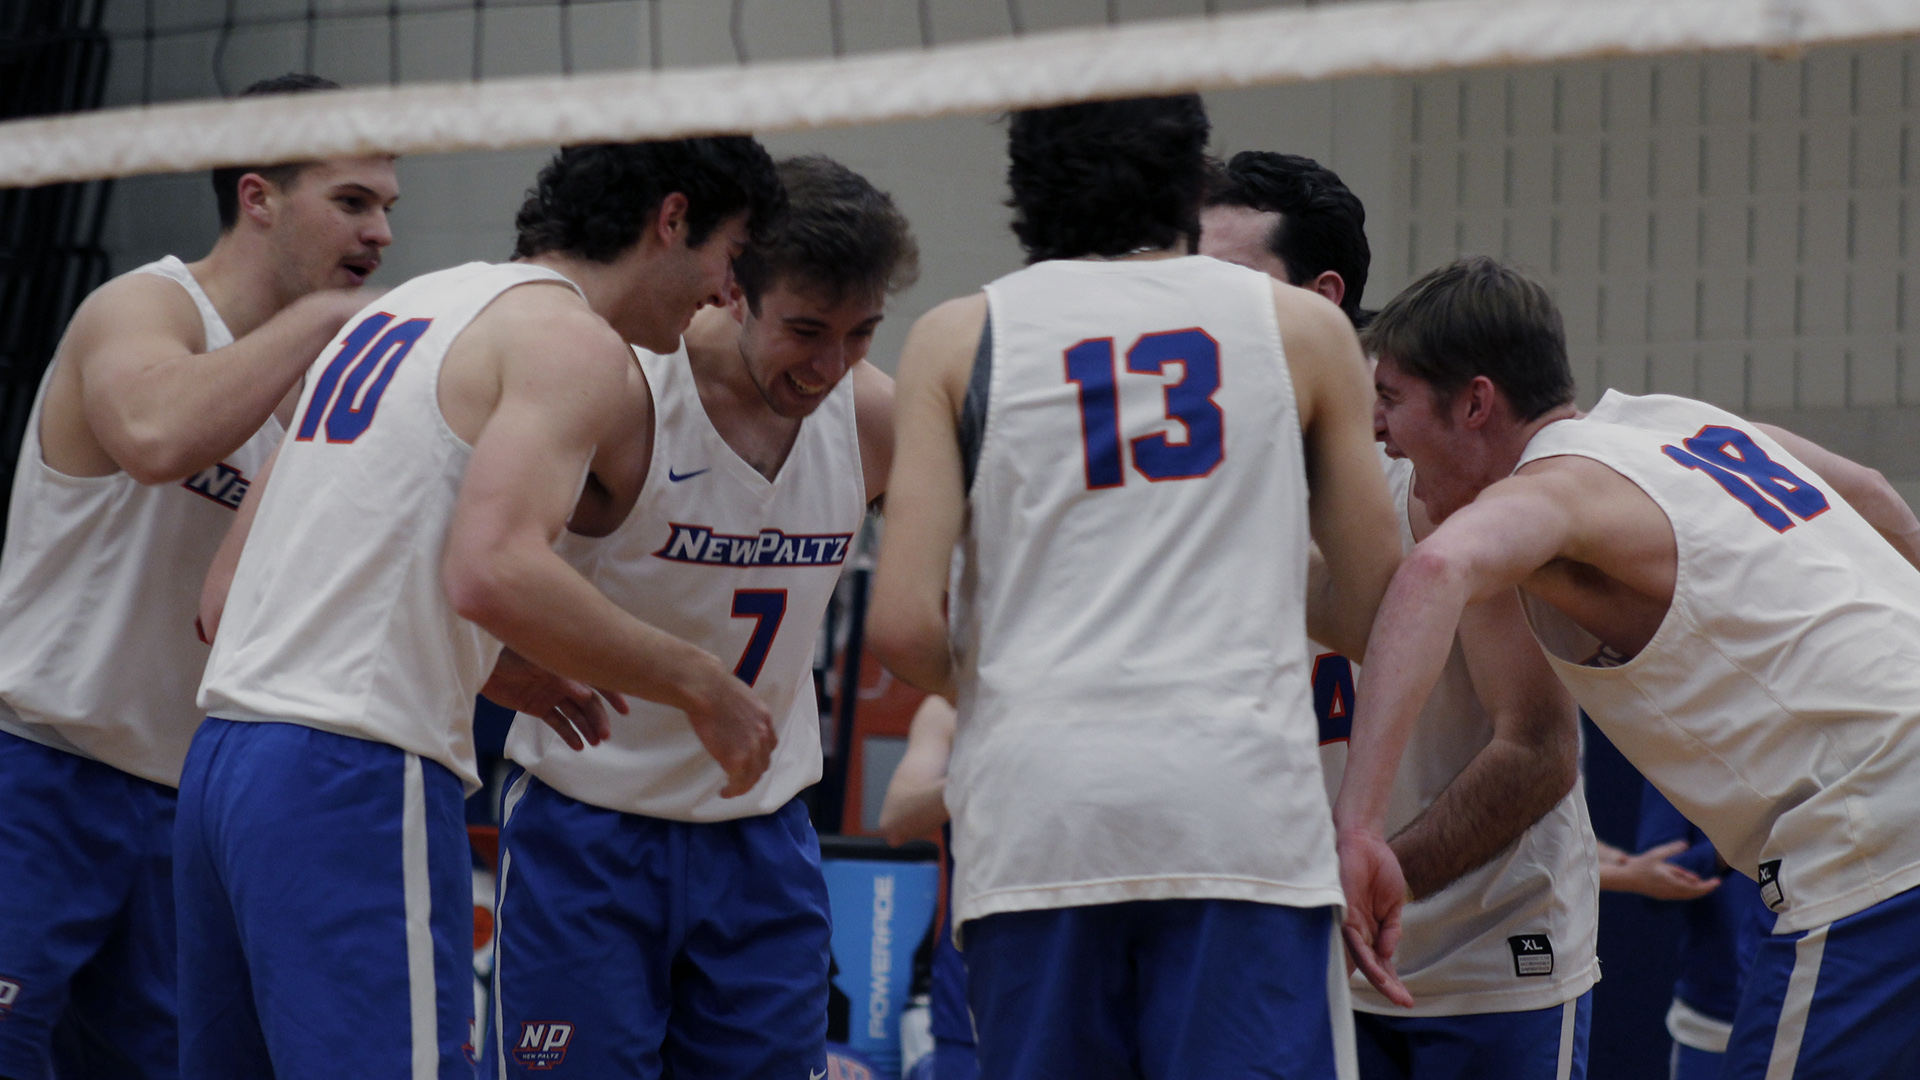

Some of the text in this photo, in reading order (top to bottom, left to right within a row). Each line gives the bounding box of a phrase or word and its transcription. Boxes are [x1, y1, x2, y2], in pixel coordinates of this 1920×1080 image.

[295, 311, 434, 444] 10
[1063, 326, 1225, 490] 13
[1661, 425, 1830, 534] 18
[731, 588, 787, 688] 7
[868, 875, 895, 1040] POWERADE
[1520, 938, 1544, 951] XL
[520, 1024, 572, 1052] NP
